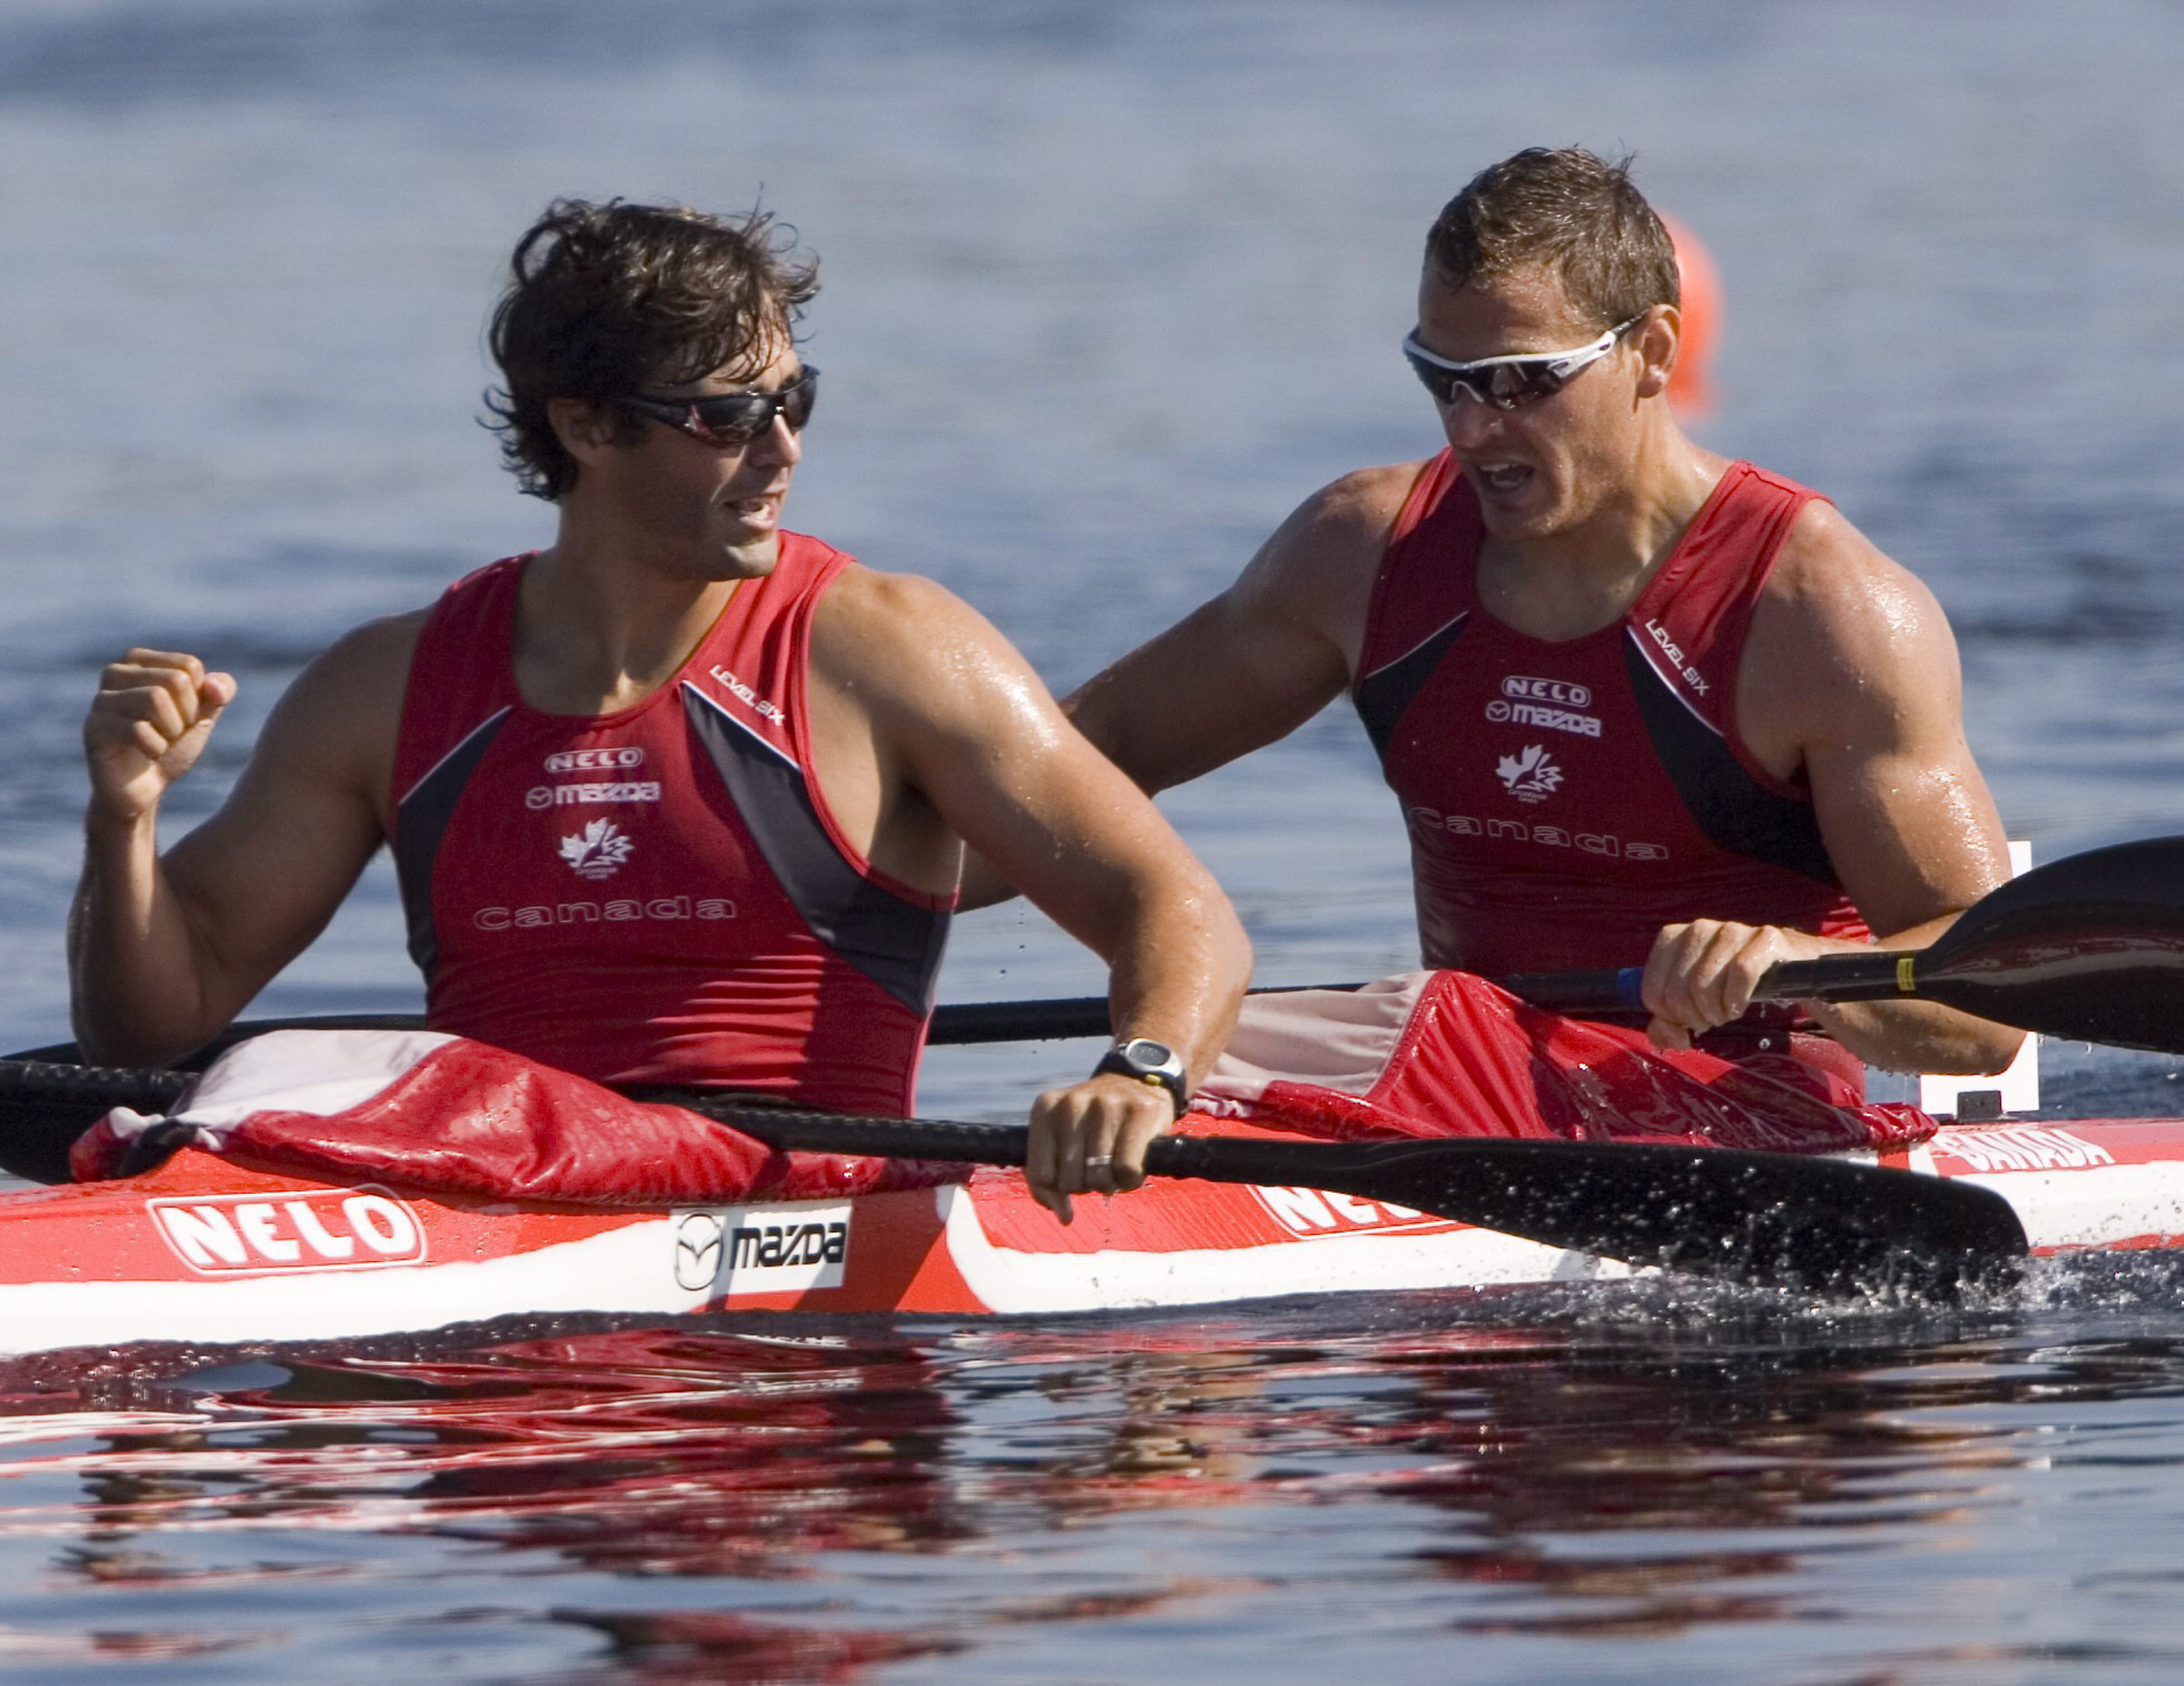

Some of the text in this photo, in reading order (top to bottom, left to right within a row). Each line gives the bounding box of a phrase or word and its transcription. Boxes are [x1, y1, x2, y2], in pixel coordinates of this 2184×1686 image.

[1645, 619, 1709, 697] LEVEL SIX
[709, 664, 785, 726] LEVEL SIX
[1504, 679, 1589, 704] NELO
[1512, 704, 1602, 737] mazda
[548, 748, 640, 772] NELO
[555, 782, 661, 804] mazda
[157, 1194, 418, 1266] NELO
[730, 1221, 847, 1270] mazda
